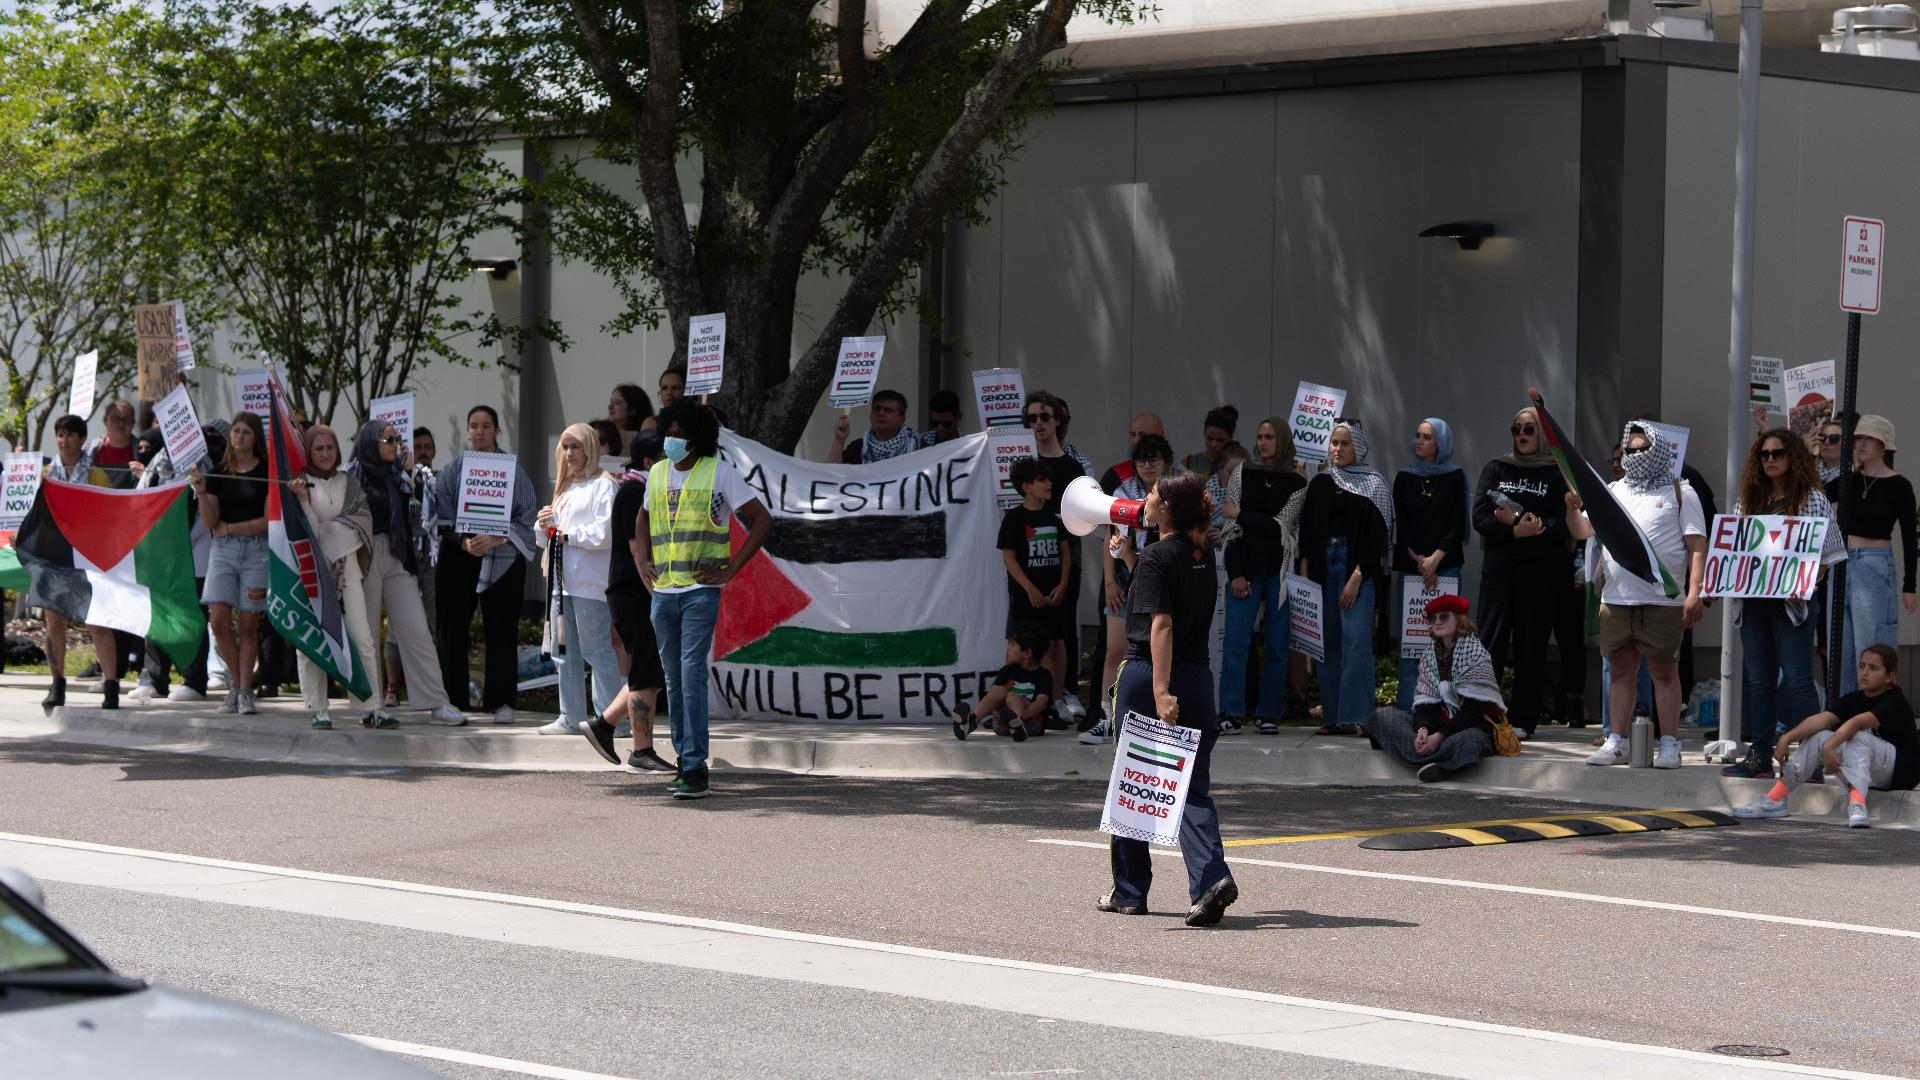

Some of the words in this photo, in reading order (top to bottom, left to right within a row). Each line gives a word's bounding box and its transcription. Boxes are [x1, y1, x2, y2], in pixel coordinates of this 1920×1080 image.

[1857, 244, 1868, 252] JTA
[1848, 255, 1875, 265] PARKING
[1851, 267, 1872, 276] RESERVED
[692, 336, 720, 345] ANOTHER
[692, 346, 707, 354] DIME
[1786, 368, 1805, 382] FREE
[982, 385, 1002, 393] STOP
[981, 393, 1021, 402] GENOCIDE
[1305, 394, 1319, 404] LIFT
[1321, 398, 1335, 407] THE
[168, 402, 179, 415] NOT
[984, 403, 994, 411] IN
[995, 402, 1020, 411] GAZA!
[1298, 403, 1320, 415] SIEGE
[1321, 409, 1336, 418] ON
[164, 405, 189, 429] ANOTHER
[376, 412, 393, 420] STOP
[1295, 414, 1330, 431] GAZA
[166, 424, 180, 438] DIME
[181, 414, 192, 426] FOR
[1293, 429, 1327, 445] NOW
[997, 446, 1016, 454] STOP
[11, 464, 22, 472] LIFT
[24, 463, 35, 471] THE
[469, 469, 490, 478] STOP
[492, 471, 507, 479] THE
[7, 474, 24, 482] SIEGE
[25, 474, 36, 482] ON
[466, 478, 509, 489] GENOCIDE
[718, 445, 975, 514] ALESTINE
[6, 485, 34, 497] GAZA
[466, 488, 476, 496] IN
[478, 489, 505, 498] GAZA!
[6, 500, 32, 511] NOW
[1714, 516, 1765, 552] END
[1782, 519, 1824, 553] THE
[1028, 539, 1058, 557] FREE
[1028, 557, 1060, 567] PALESTIN
[1705, 554, 1816, 596] OCCUPATION
[1297, 588, 1311, 597] NOT
[1290, 595, 1318, 611] ANOTHER
[1290, 604, 1305, 615] DIME
[1306, 609, 1318, 619] FOR
[711, 666, 818, 720] WILL
[824, 671, 884, 720] BE
[1123, 767, 1160, 789] GAZA!
[1162, 779, 1178, 792] IN
[1119, 780, 1175, 806] GENOCIDE
[1118, 795, 1135, 811] THE
[1138, 803, 1169, 819] STOP
